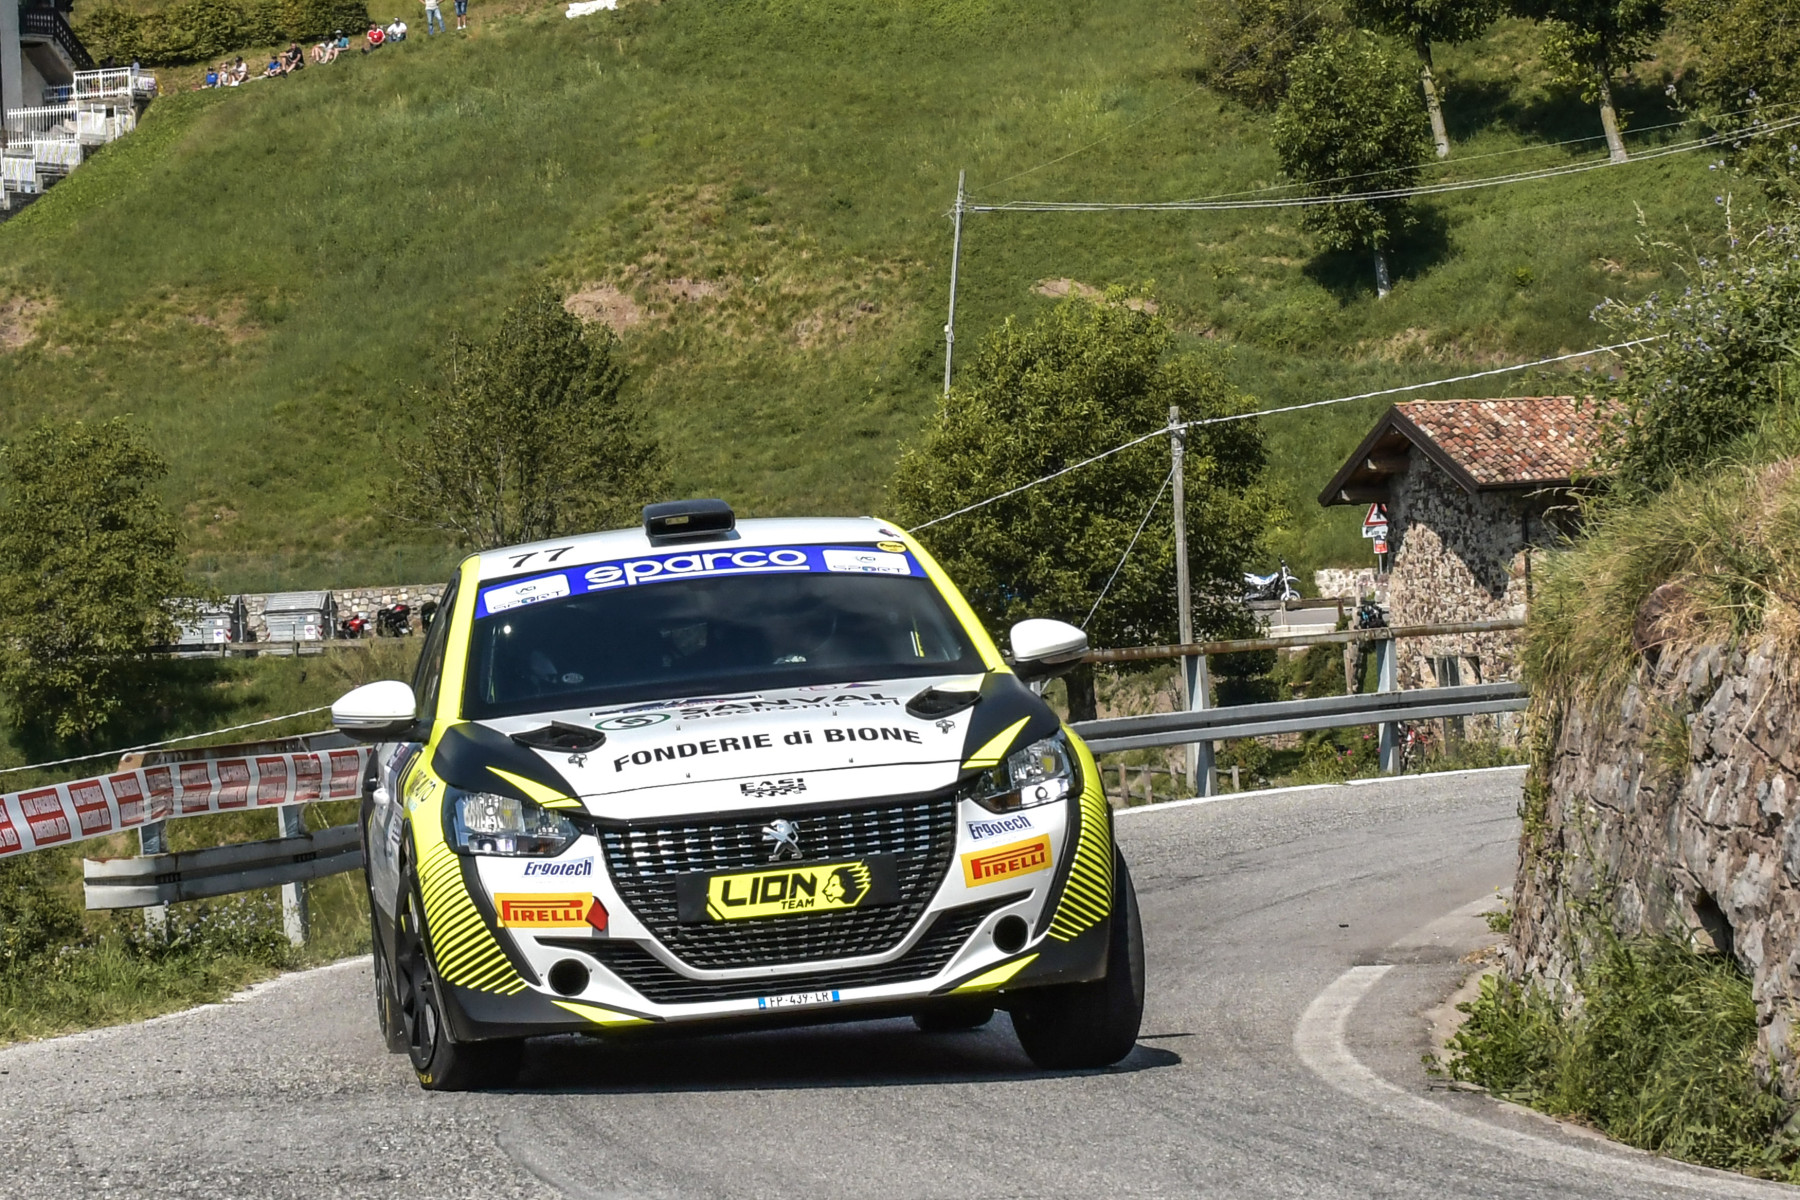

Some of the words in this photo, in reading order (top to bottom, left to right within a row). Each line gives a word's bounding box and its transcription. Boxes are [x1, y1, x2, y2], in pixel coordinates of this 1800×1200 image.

[508, 545, 575, 569] 77
[584, 549, 808, 586] sparco
[679, 693, 899, 716] SANVAL
[682, 702, 851, 721] electronic
[862, 698, 901, 707] srl
[613, 733, 773, 773] FONDERIE
[783, 729, 813, 746] di
[823, 727, 923, 745] BIONE
[967, 814, 1032, 840] Ergotech
[523, 858, 592, 876] Ergotech
[970, 842, 1046, 881] PIRELLI
[720, 871, 818, 908] LION
[501, 899, 584, 922] PIRELLI
[780, 897, 815, 911] TEAM
